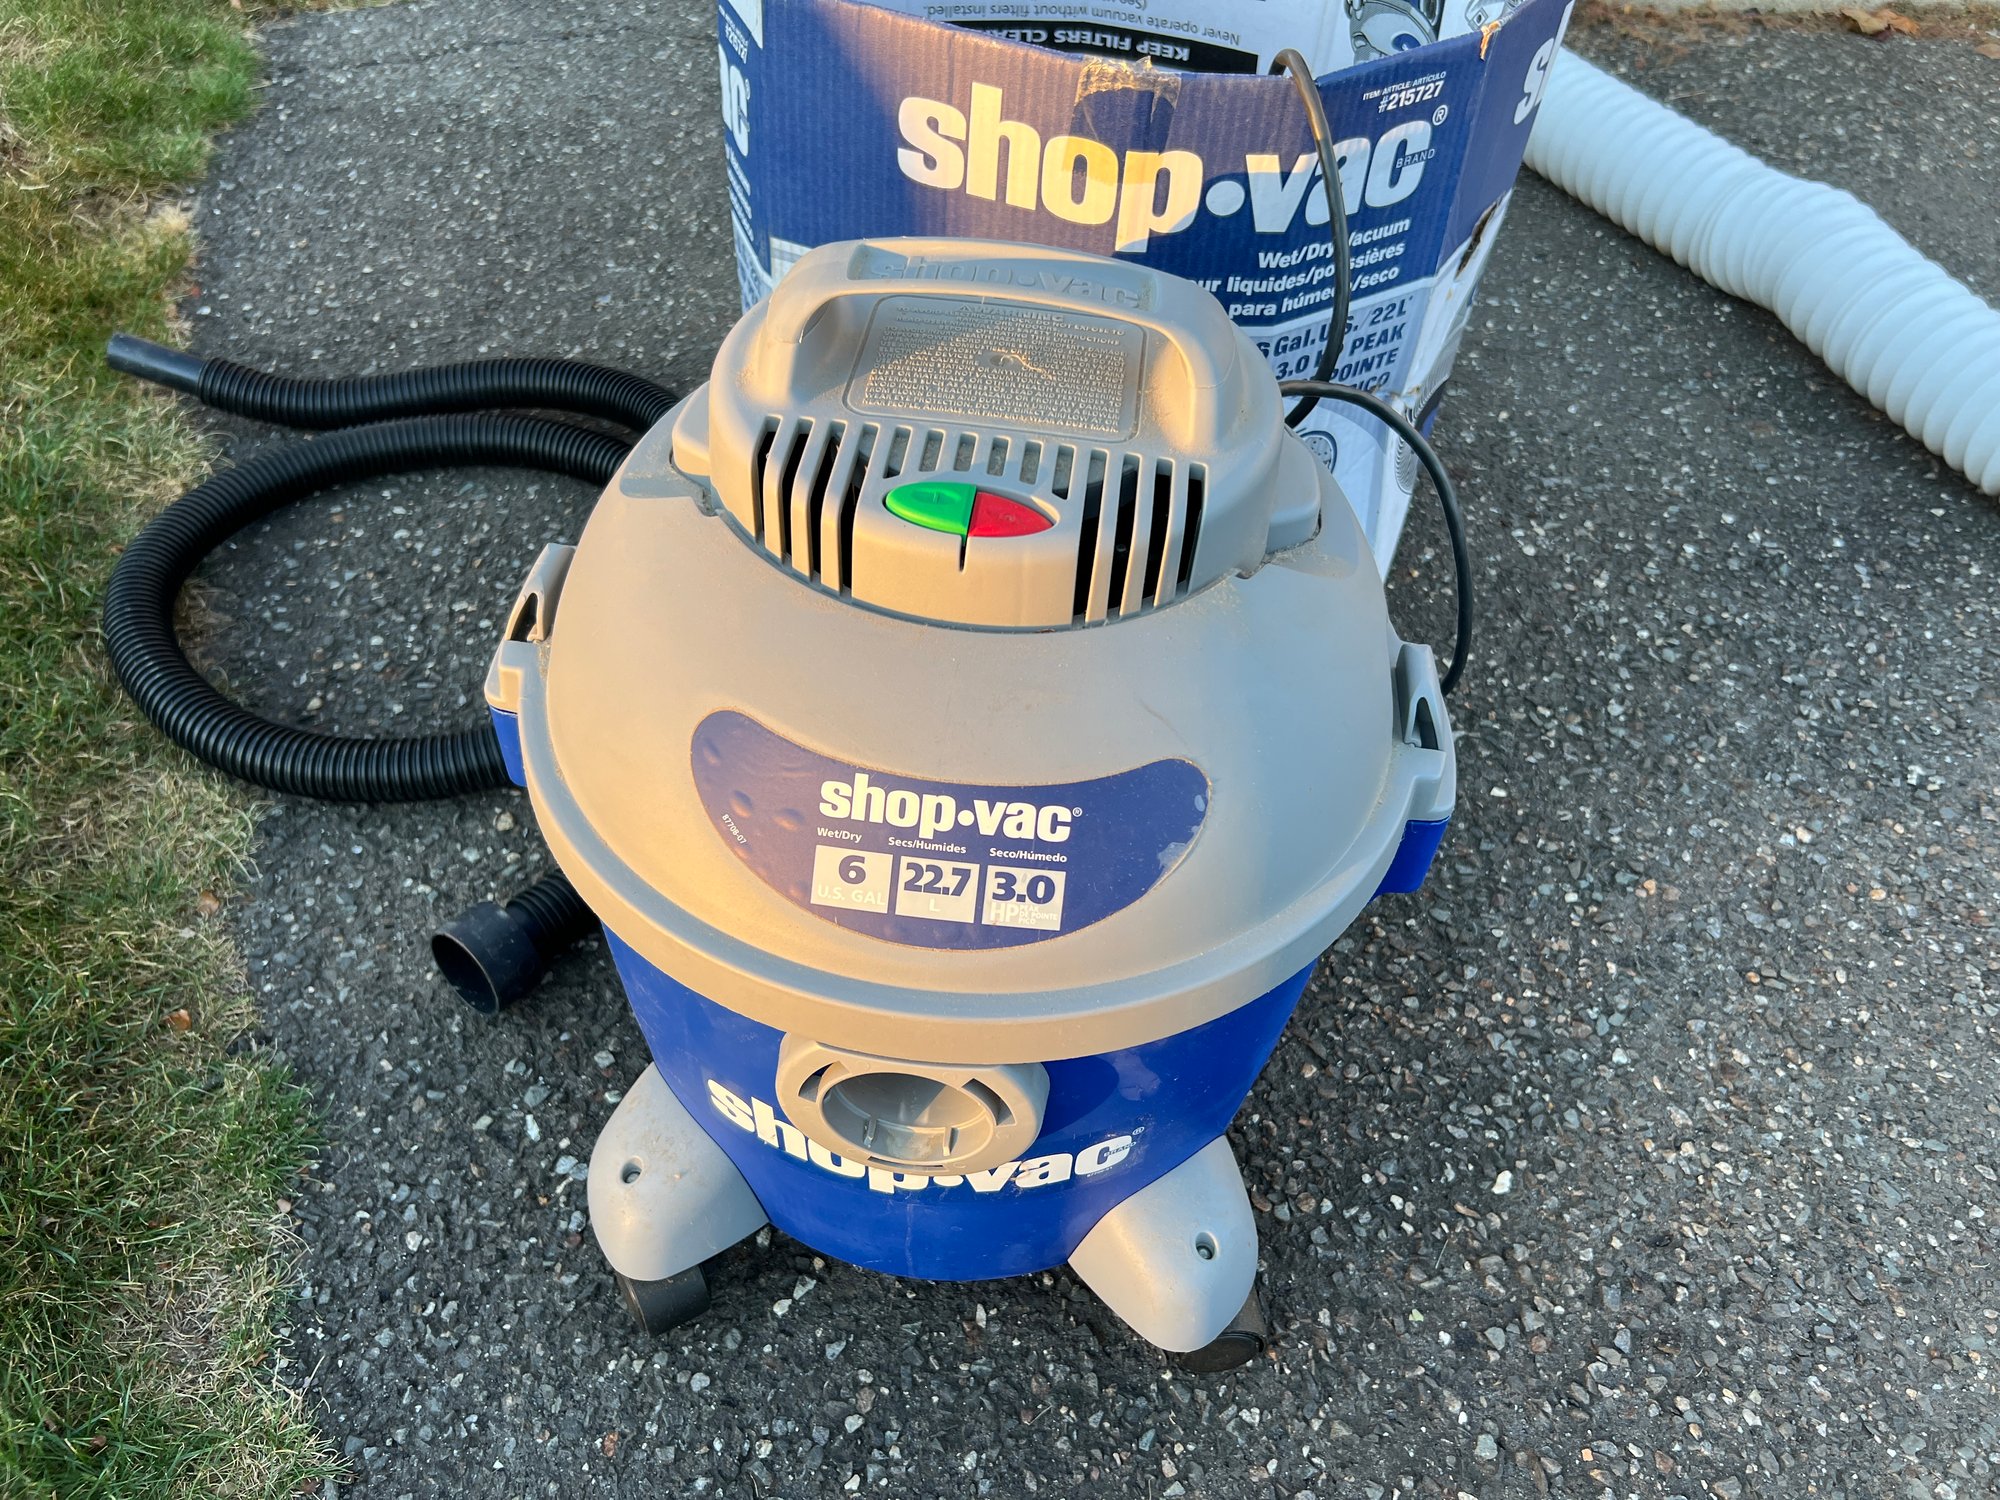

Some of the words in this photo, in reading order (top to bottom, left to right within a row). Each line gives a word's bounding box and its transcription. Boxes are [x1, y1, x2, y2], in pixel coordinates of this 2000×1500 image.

[923, 4, 986, 16] installed.
[989, 4, 1030, 16] filters
[1033, 4, 1088, 16] without
[1091, 9, 1143, 25] vacuum
[1146, 16, 1199, 34] operate
[985, 28, 1048, 43] CLEA
[1053, 28, 1132, 51] FILTERS
[1202, 28, 1241, 46] Never
[1136, 40, 1191, 62] KEEP
[1378, 80, 1444, 113] #215727
[1395, 148, 1436, 169] BRAND
[1258, 242, 1334, 268] Wet/Dry
[1226, 241, 1406, 296] liquides/possières
[971, 304, 1065, 322] WARNING
[1228, 303, 1277, 319] para
[959, 332, 991, 340] HEALTH
[930, 355, 959, 363] CAUSE
[1276, 355, 1309, 381] 3.0
[1348, 323, 1406, 357] PEAK
[919, 378, 944, 386] SUCH
[1010, 388, 1032, 396] LEAD
[974, 372, 1013, 381] VACUUM
[1016, 377, 1041, 385] TOXIC
[984, 379, 1016, 388] OTHER
[1017, 383, 1052, 393] HEALTH
[937, 386, 972, 395] HEALTH
[974, 390, 1013, 400] HAZARD
[1030, 396, 1077, 408] PROPERTY
[1079, 403, 1120, 413] DAMAGE
[978, 396, 1001, 405] DUST
[1003, 399, 1029, 408] WHEN
[722, 814, 747, 844] 87708-07
[817, 827, 862, 843] Wet/Dry
[888, 836, 967, 855] Secs/Humides
[989, 847, 1068, 863] Seco/Húmedo
[838, 855, 867, 885] 6
[904, 862, 971, 897] 22.7
[991, 871, 1056, 905] 3.0
[817, 883, 846, 901] U.S.
[851, 889, 886, 907] GAL
[928, 898, 941, 912] L
[990, 902, 1020, 923] HP
[1031, 912, 1058, 921] POINTE
